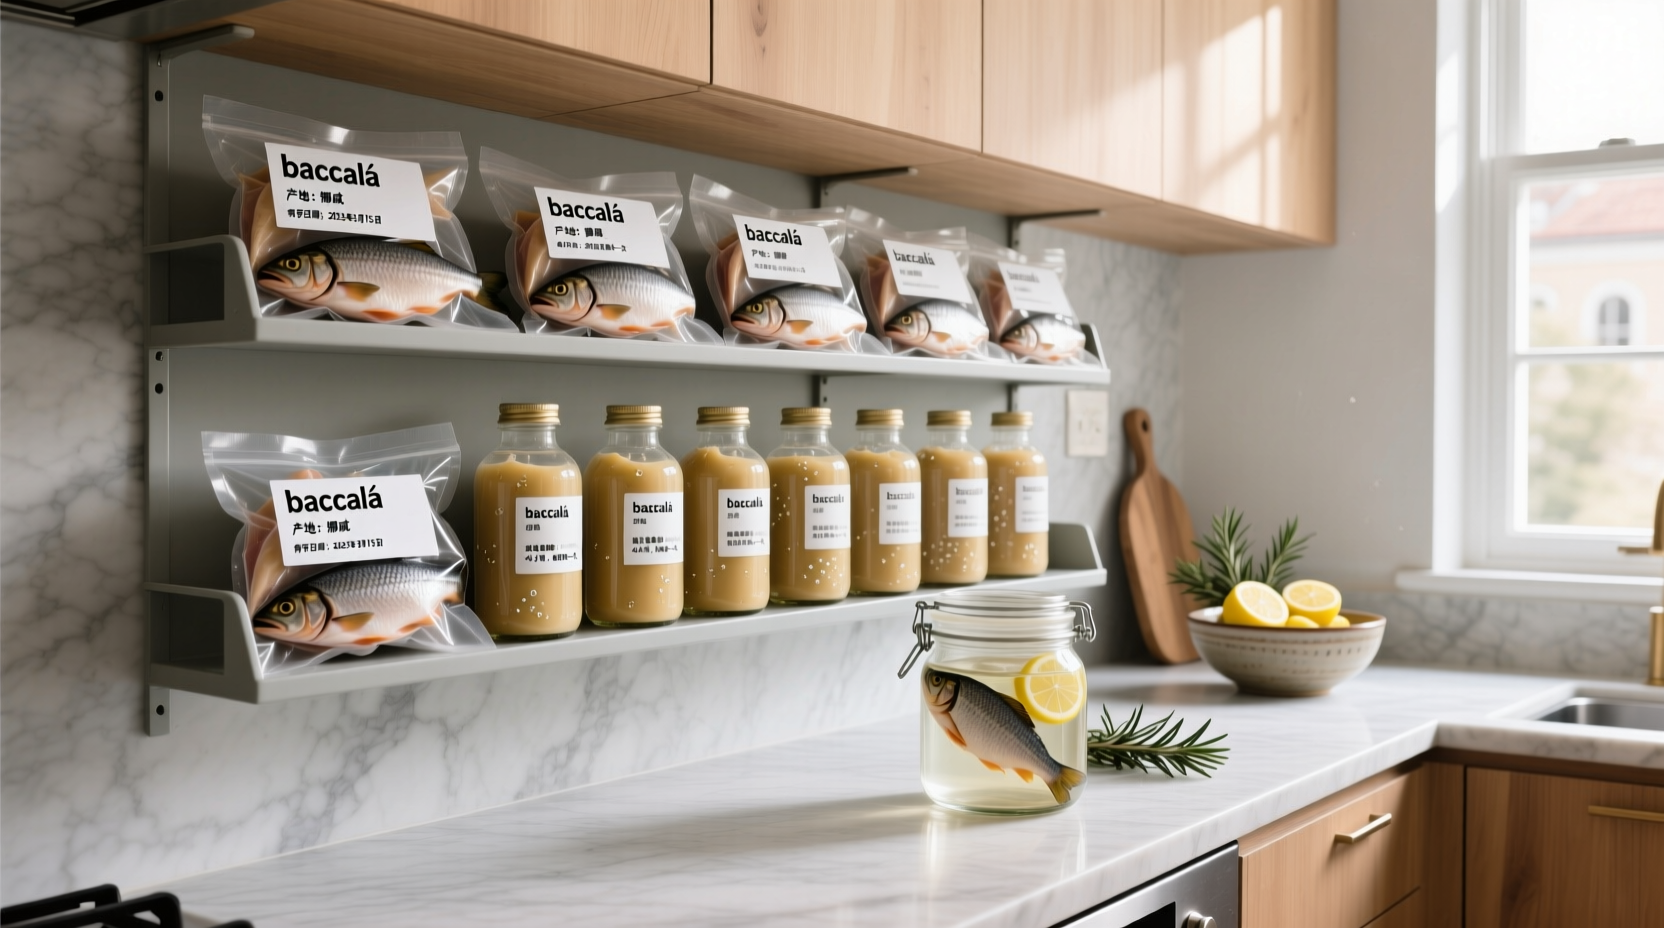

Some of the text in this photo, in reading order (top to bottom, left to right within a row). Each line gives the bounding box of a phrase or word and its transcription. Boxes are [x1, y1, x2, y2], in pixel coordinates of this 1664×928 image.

[281, 153, 380, 188] baccalá
[547, 197, 625, 223] baccalá
[744, 224, 803, 245] baccalá
[285, 485, 383, 513] baccalá
[525, 505, 569, 518] baccalá
